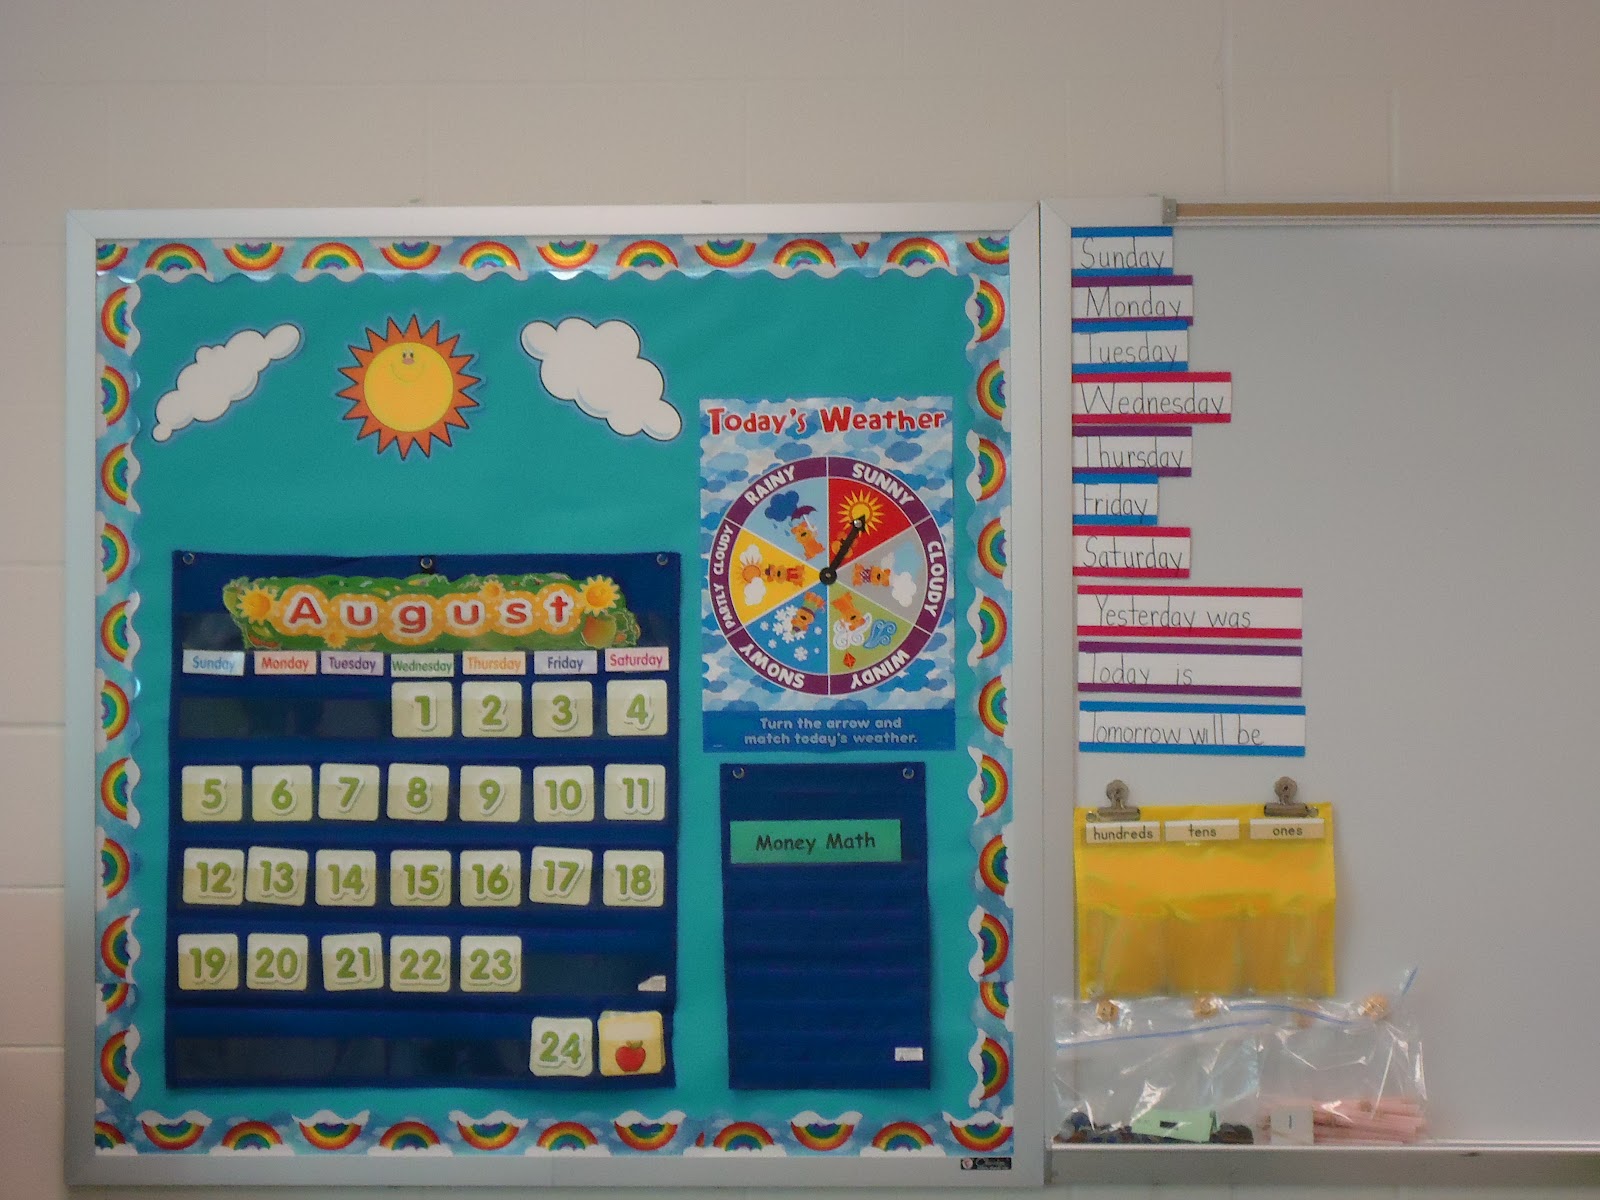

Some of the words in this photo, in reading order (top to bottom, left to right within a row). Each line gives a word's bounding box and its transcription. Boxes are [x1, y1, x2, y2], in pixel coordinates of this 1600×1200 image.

[1079, 236, 1165, 275] Sunday
[1085, 285, 1182, 321] Monday
[1079, 331, 1178, 371] Tuesday
[1080, 381, 1224, 417] Wednesday
[707, 407, 807, 435] Today's
[819, 406, 946, 434] Weather
[1080, 435, 1184, 473] Thursday
[743, 465, 798, 507] RAINY
[851, 462, 916, 506] SUNNY
[1082, 482, 1148, 524] Friday
[713, 524, 734, 576] CLOUDY
[1082, 535, 1182, 576] Saturday
[926, 539, 945, 619] CLOUDY
[287, 594, 574, 635] August
[711, 583, 737, 630] PARTLY
[1095, 594, 1196, 634] Yesterday
[1206, 610, 1251, 629] was
[192, 654, 236, 672] Sunday
[261, 654, 310, 672] Monday
[327, 654, 376, 673] Tuesday
[391, 657, 453, 675] Wednesday
[466, 654, 522, 673] Thursday
[546, 654, 584, 673] Friday
[609, 650, 664, 669] Saturday
[739, 644, 806, 690] SNOWY
[850, 648, 909, 690] WINDY
[1084, 651, 1150, 689] Today
[1174, 663, 1194, 686] is
[416, 695, 431, 727] 1
[483, 695, 502, 726] 2
[552, 695, 574, 726] 3
[626, 693, 648, 725] 4
[760, 716, 793, 730] Turn
[797, 716, 823, 730] the
[827, 717, 871, 730] arrow
[875, 716, 902, 730] and
[744, 731, 791, 745] match
[794, 731, 849, 748] today's
[853, 731, 918, 745] weather.
[1083, 709, 1182, 744] Tomorrow
[1188, 713, 1224, 746] will
[1236, 713, 1265, 746] be
[203, 778, 223, 810] 5
[272, 780, 294, 812] 6
[339, 777, 360, 812] 7
[407, 777, 428, 809] 8
[480, 779, 501, 811] 9
[546, 779, 583, 811] 10
[624, 778, 650, 809] 11
[755, 834, 817, 855] Money
[825, 832, 877, 850] Math
[1093, 826, 1154, 840] hundreds
[1188, 824, 1217, 838] tens
[1272, 826, 1303, 836] ones
[198, 862, 233, 895] 12
[261, 860, 295, 894] 13
[329, 864, 365, 895] 14
[404, 864, 441, 897] 15
[473, 864, 510, 896] 16
[545, 860, 580, 894] 17
[617, 864, 652, 896] 18
[191, 947, 227, 980] 19
[256, 947, 299, 979] 20
[336, 947, 373, 980] 21
[400, 948, 442, 981] 22
[471, 949, 514, 981] 23
[541, 1031, 583, 1064] 24
